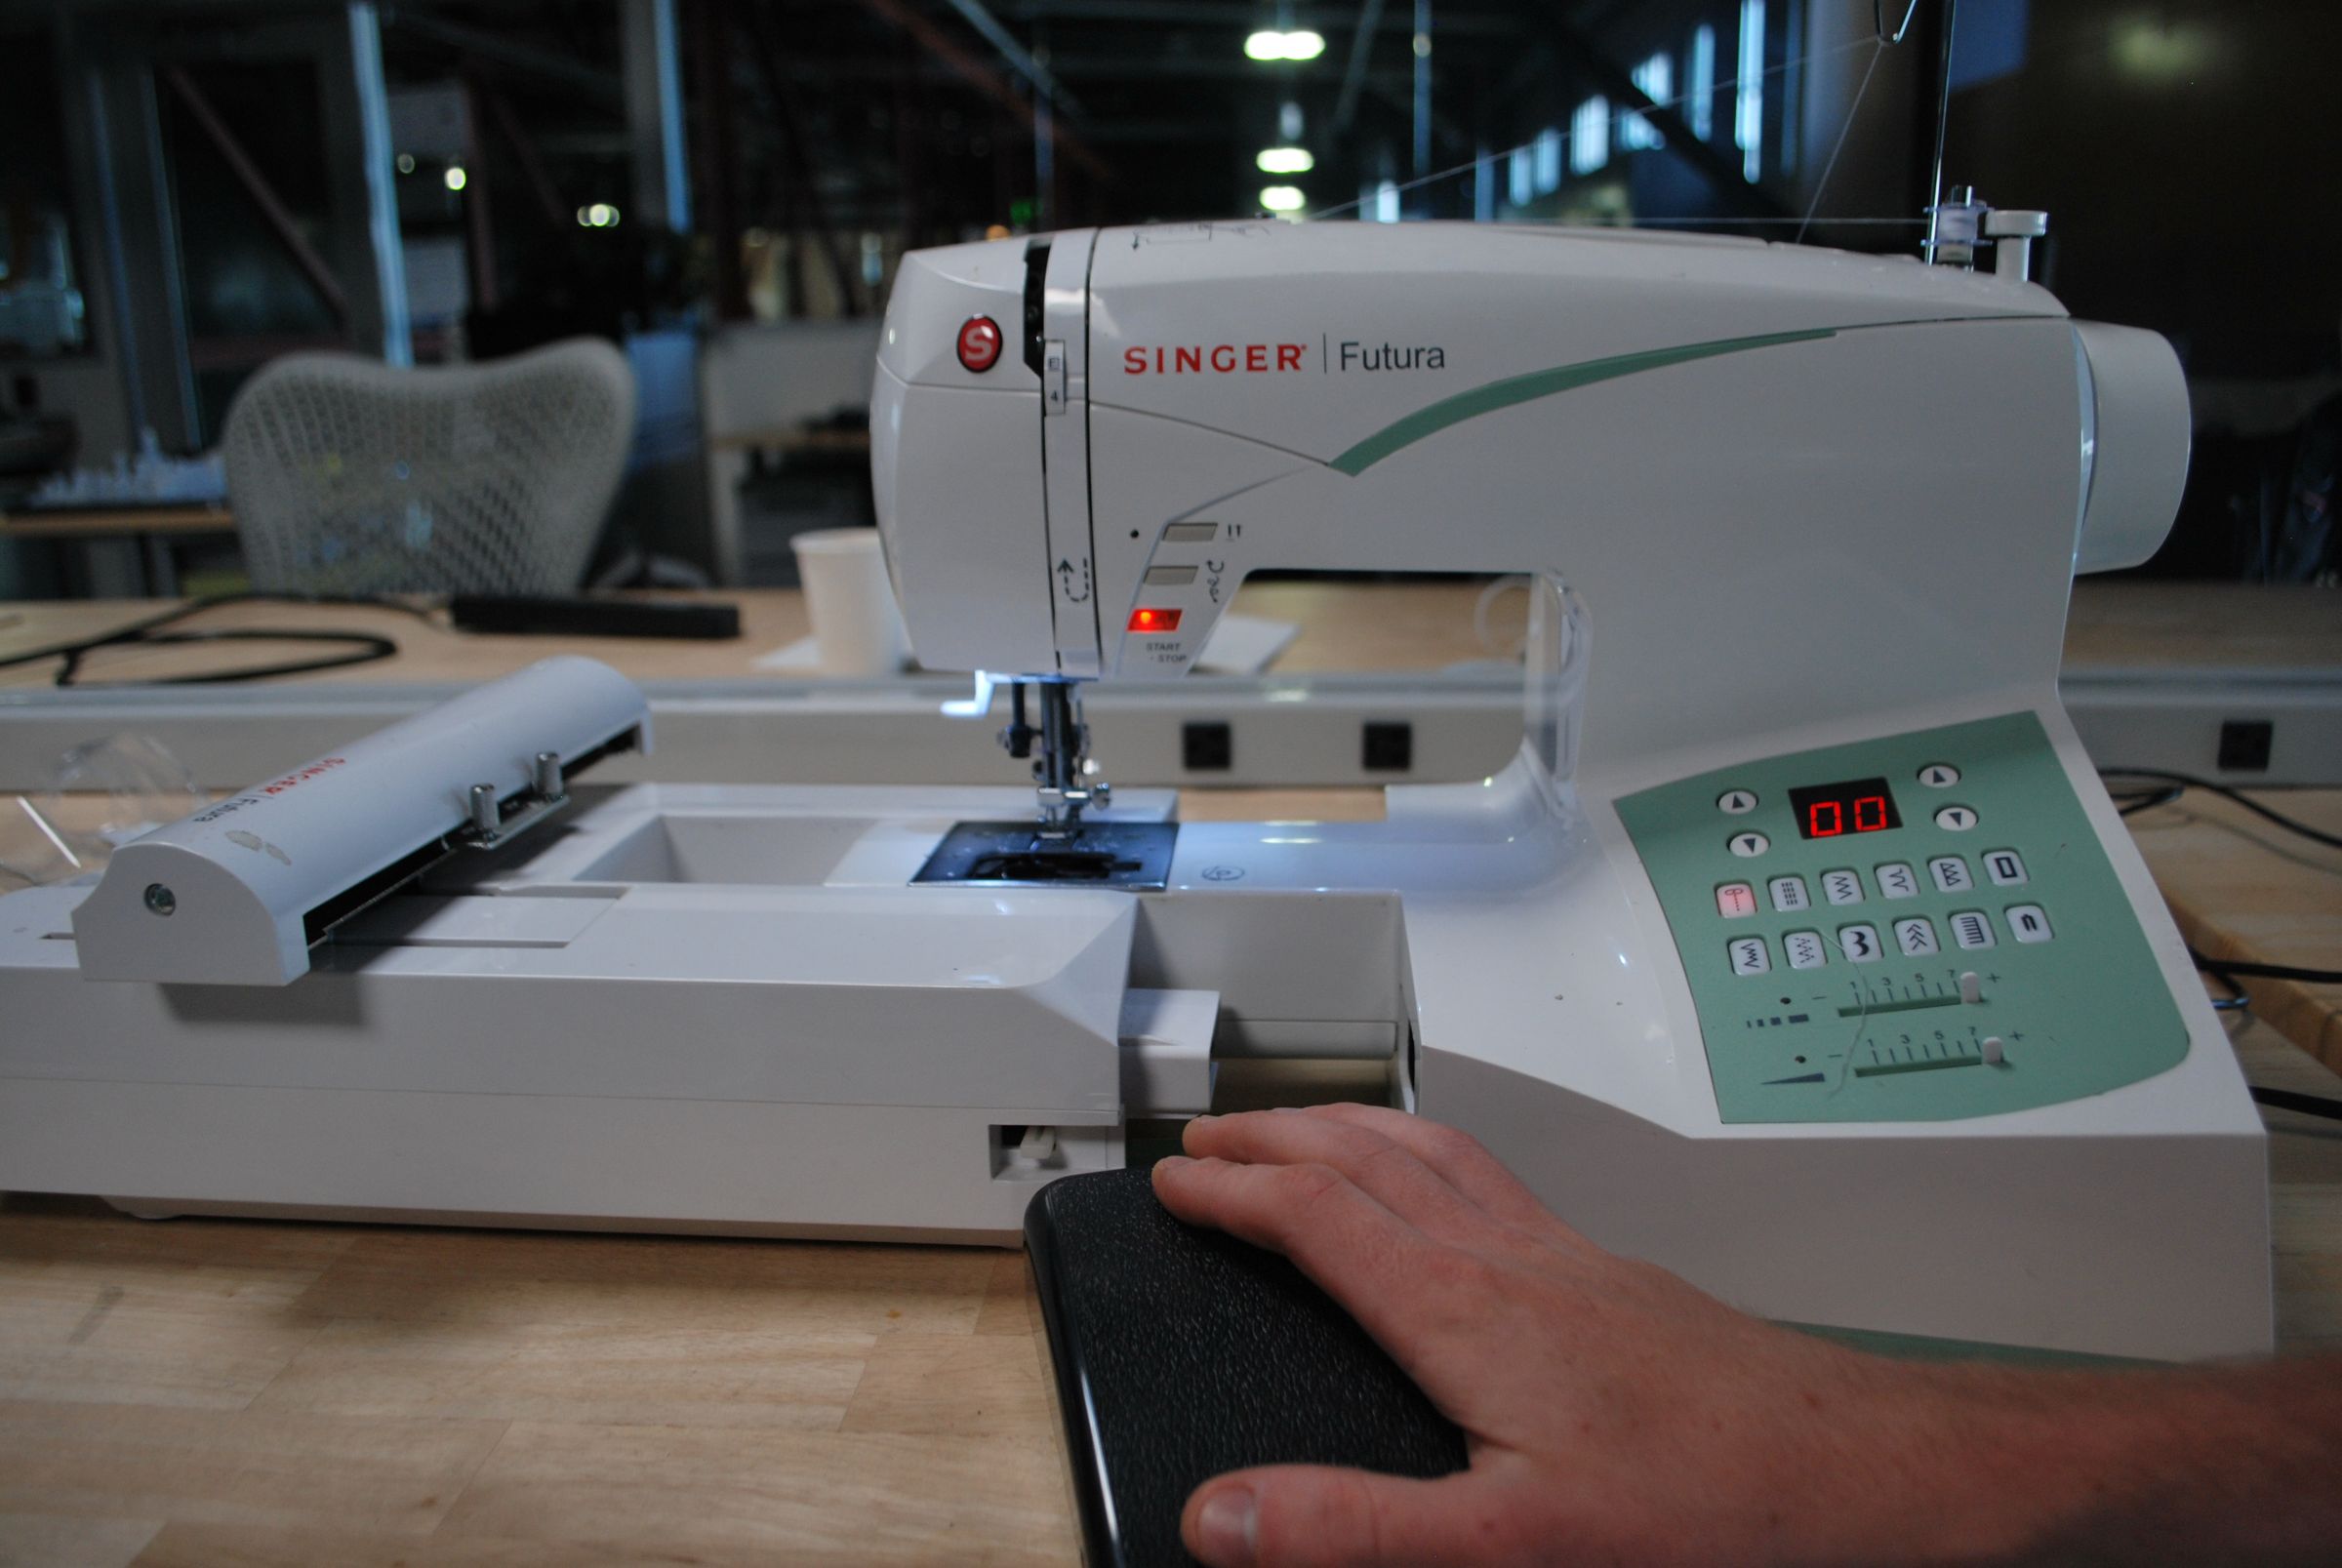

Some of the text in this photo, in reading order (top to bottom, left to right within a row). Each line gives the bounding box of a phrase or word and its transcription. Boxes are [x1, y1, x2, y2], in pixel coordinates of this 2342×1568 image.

[964, 326, 992, 361] S
[1123, 341, 1445, 375] SINGER Futura
[1146, 642, 1181, 652] START
[1810, 796, 1887, 837] 00
[1881, 977, 1891, 986] 3
[1901, 1034, 1911, 1044] 3
[1934, 1030, 1944, 1040] 5
[1967, 1026, 1976, 1036] 7
